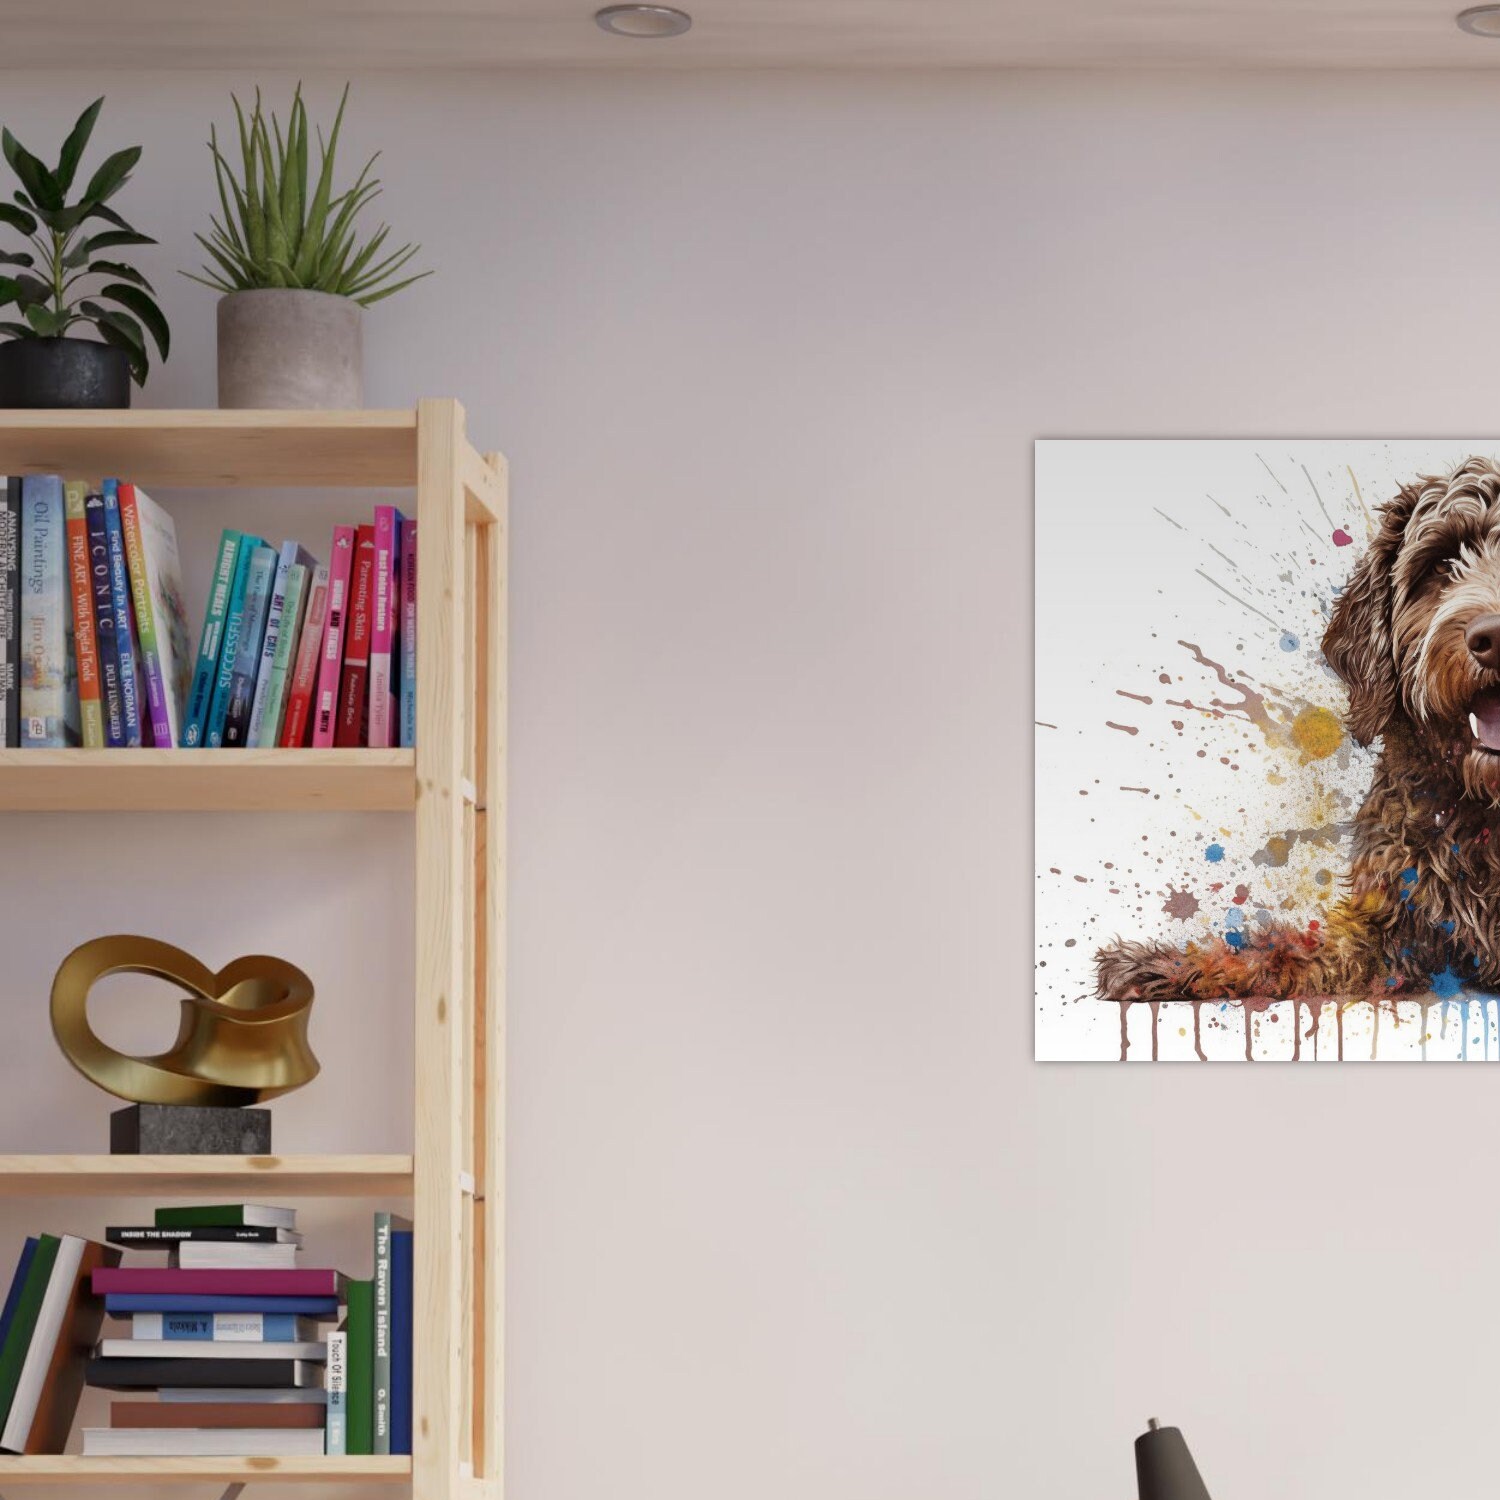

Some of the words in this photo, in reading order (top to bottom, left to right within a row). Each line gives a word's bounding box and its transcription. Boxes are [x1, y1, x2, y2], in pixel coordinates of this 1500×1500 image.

[33, 501, 51, 524] Oil
[6, 510, 17, 571] ANALYSING
[72, 535, 86, 562] FINE
[110, 530, 122, 552] Find
[28, 527, 49, 595] Paintings
[74, 563, 87, 584] ART
[112, 553, 125, 591] Beauty
[123, 503, 142, 577] Watercolor
[134, 579, 151, 633] Portraits
[356, 561, 371, 611] Parenting
[77, 593, 90, 618] With
[272, 593, 285, 611] ART
[30, 617, 47, 642] Jiro
[117, 608, 128, 629] ART
[330, 611, 341, 627] AND
[354, 613, 366, 640] Skills
[77, 620, 94, 654] Digital
[220, 611, 243, 688] SUCCESSFUL
[264, 635, 277, 658] CATS
[6, 663, 14, 690] MARK
[82, 657, 97, 682] Tools
[120, 652, 133, 677] ELLE
[123, 678, 136, 727] NORMAN
[377, 1225, 389, 1254] The
[376, 1259, 387, 1307] Raven
[377, 1310, 388, 1357] Island
[332, 1339, 342, 1362] Touch
[332, 1364, 342, 1373] Of
[332, 1376, 342, 1405] Silence
[378, 1388, 386, 1401] O.
[377, 1404, 386, 1436] Smith
